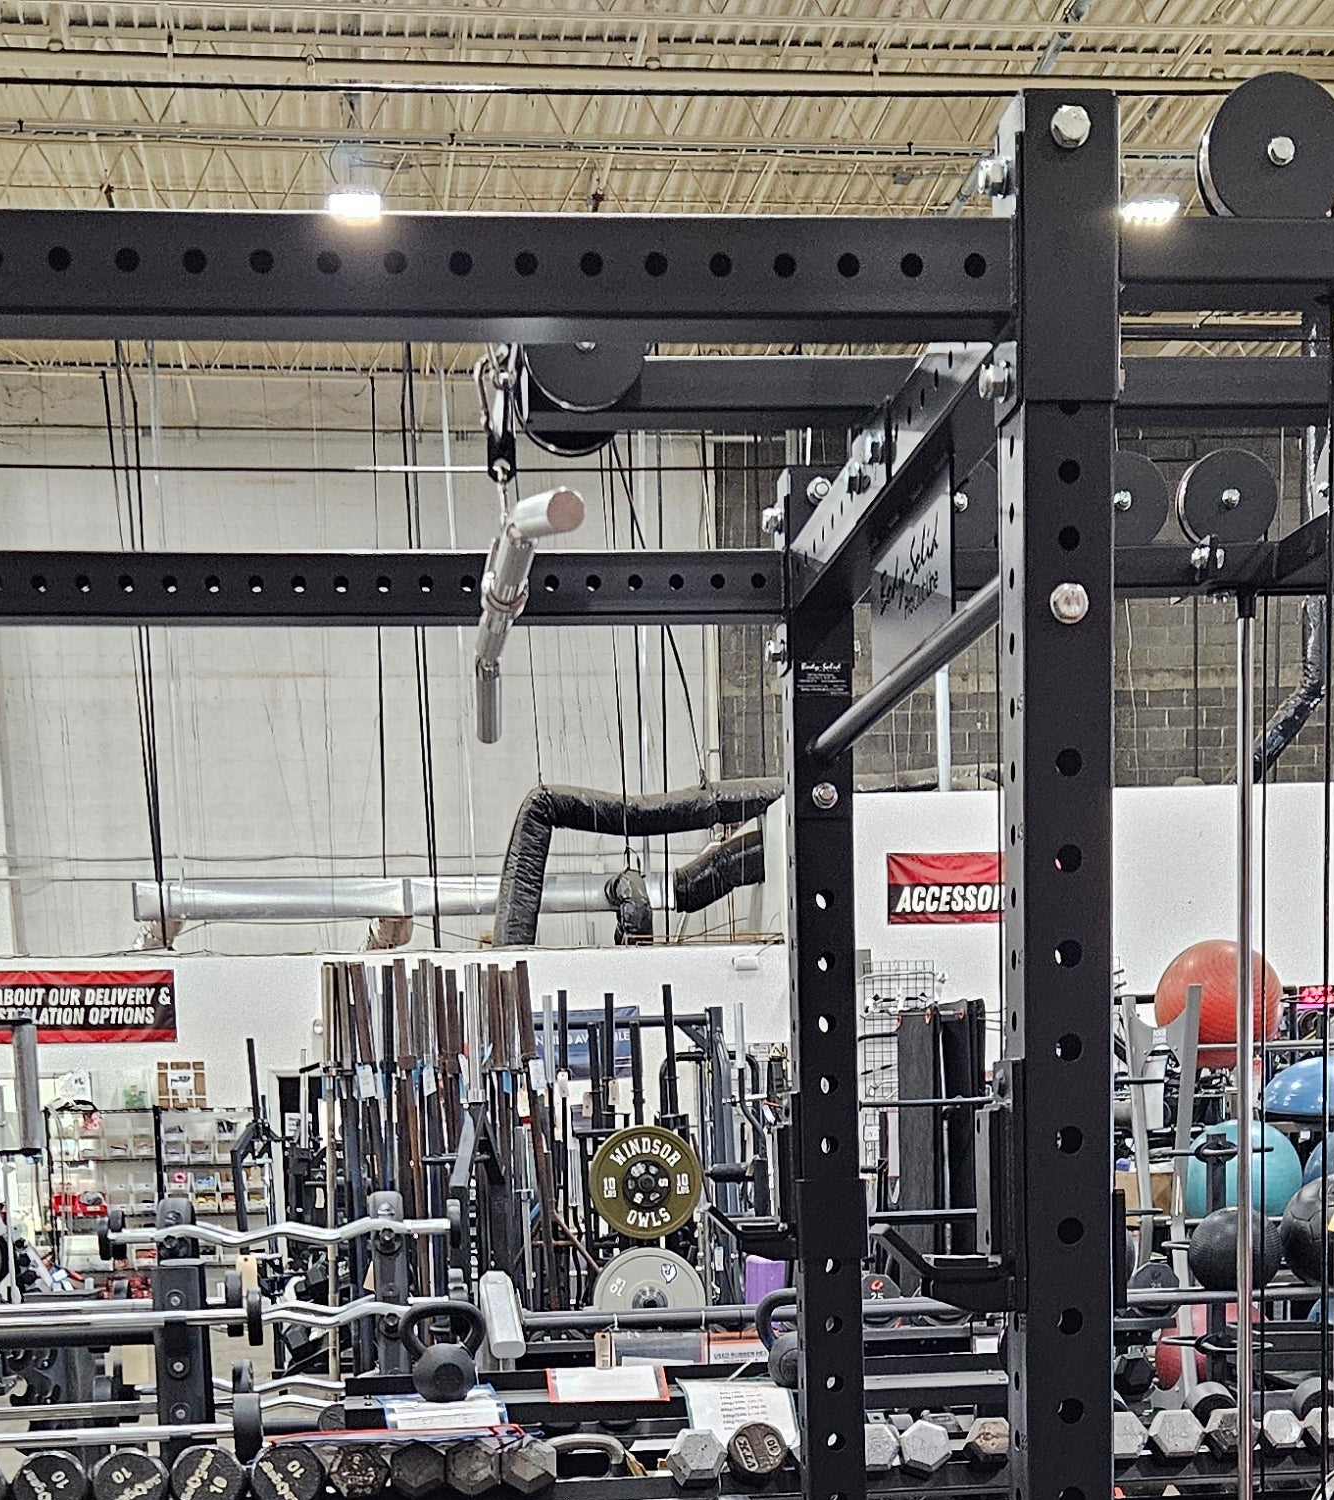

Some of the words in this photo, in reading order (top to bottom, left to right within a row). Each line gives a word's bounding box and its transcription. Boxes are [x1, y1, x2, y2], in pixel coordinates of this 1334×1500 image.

[48, 987, 82, 1006] OUR
[84, 986, 157, 1006] DELIVERY
[157, 986, 172, 1005] &
[87, 1006, 156, 1026] OPTIONS
[609, 1137, 682, 1167] WINDSOR
[603, 1177, 616, 1189] 10
[676, 1173, 689, 1186] 10
[626, 1207, 672, 1228] OWLS
[111, 1466, 133, 1484] 10
[286, 1459, 306, 1479] 10
[51, 1470, 70, 1489] 10
[209, 1475, 228, 1494] 10
